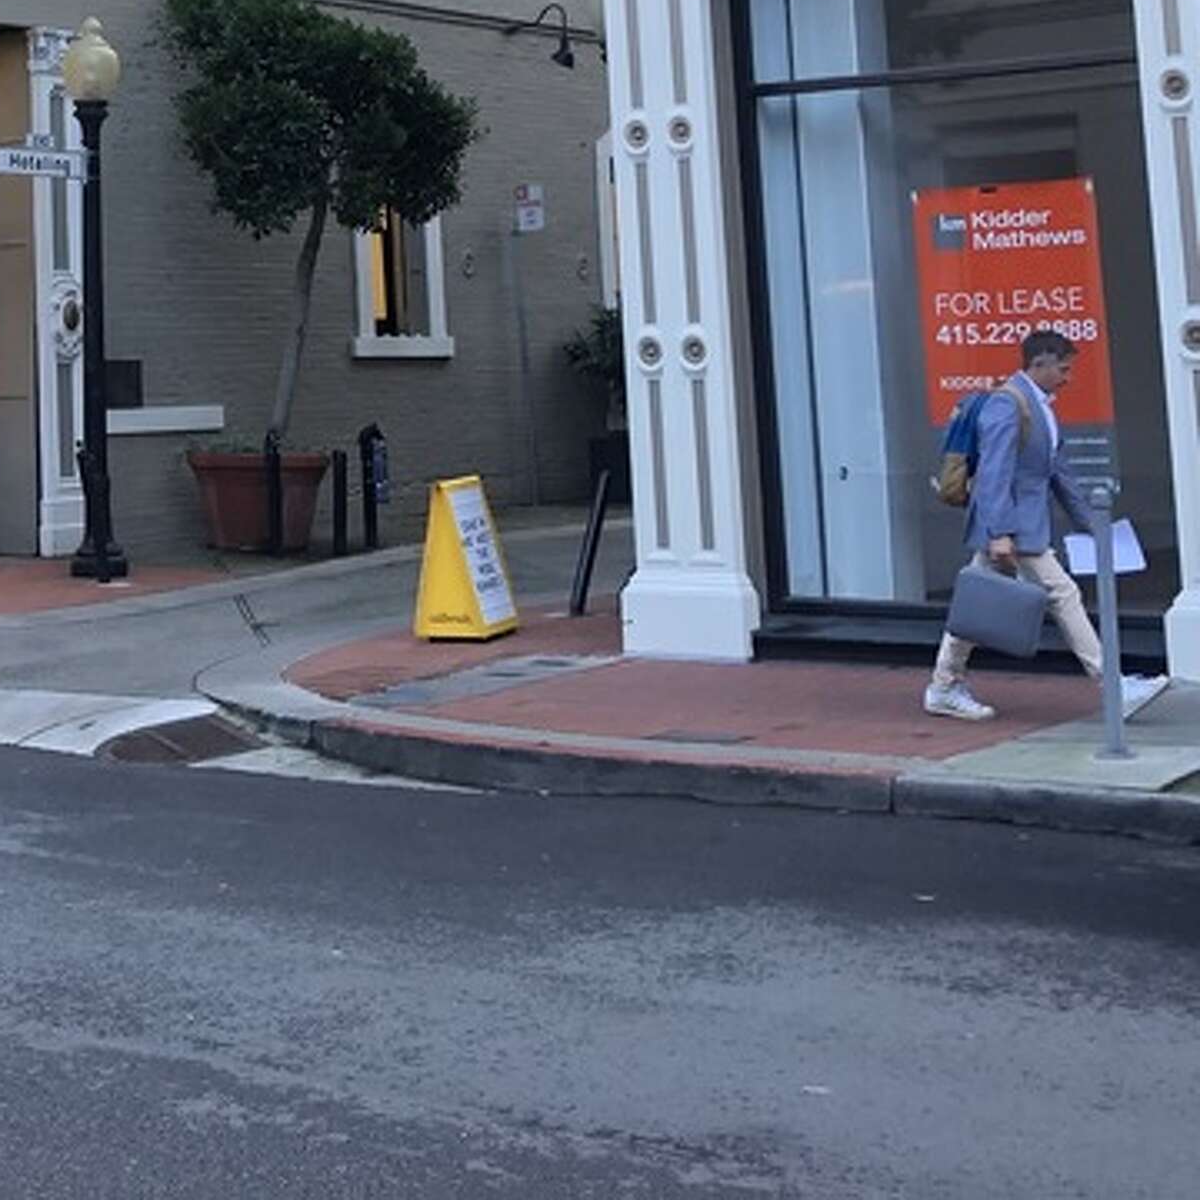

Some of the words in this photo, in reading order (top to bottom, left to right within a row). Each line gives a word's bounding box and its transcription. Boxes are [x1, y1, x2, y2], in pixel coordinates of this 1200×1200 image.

[970, 208, 1052, 230] Kidder
[972, 229, 1087, 250] Mathews
[934, 292, 991, 317] FOR
[998, 285, 1085, 315] LEASE
[935, 318, 1098, 346] 415.229888
